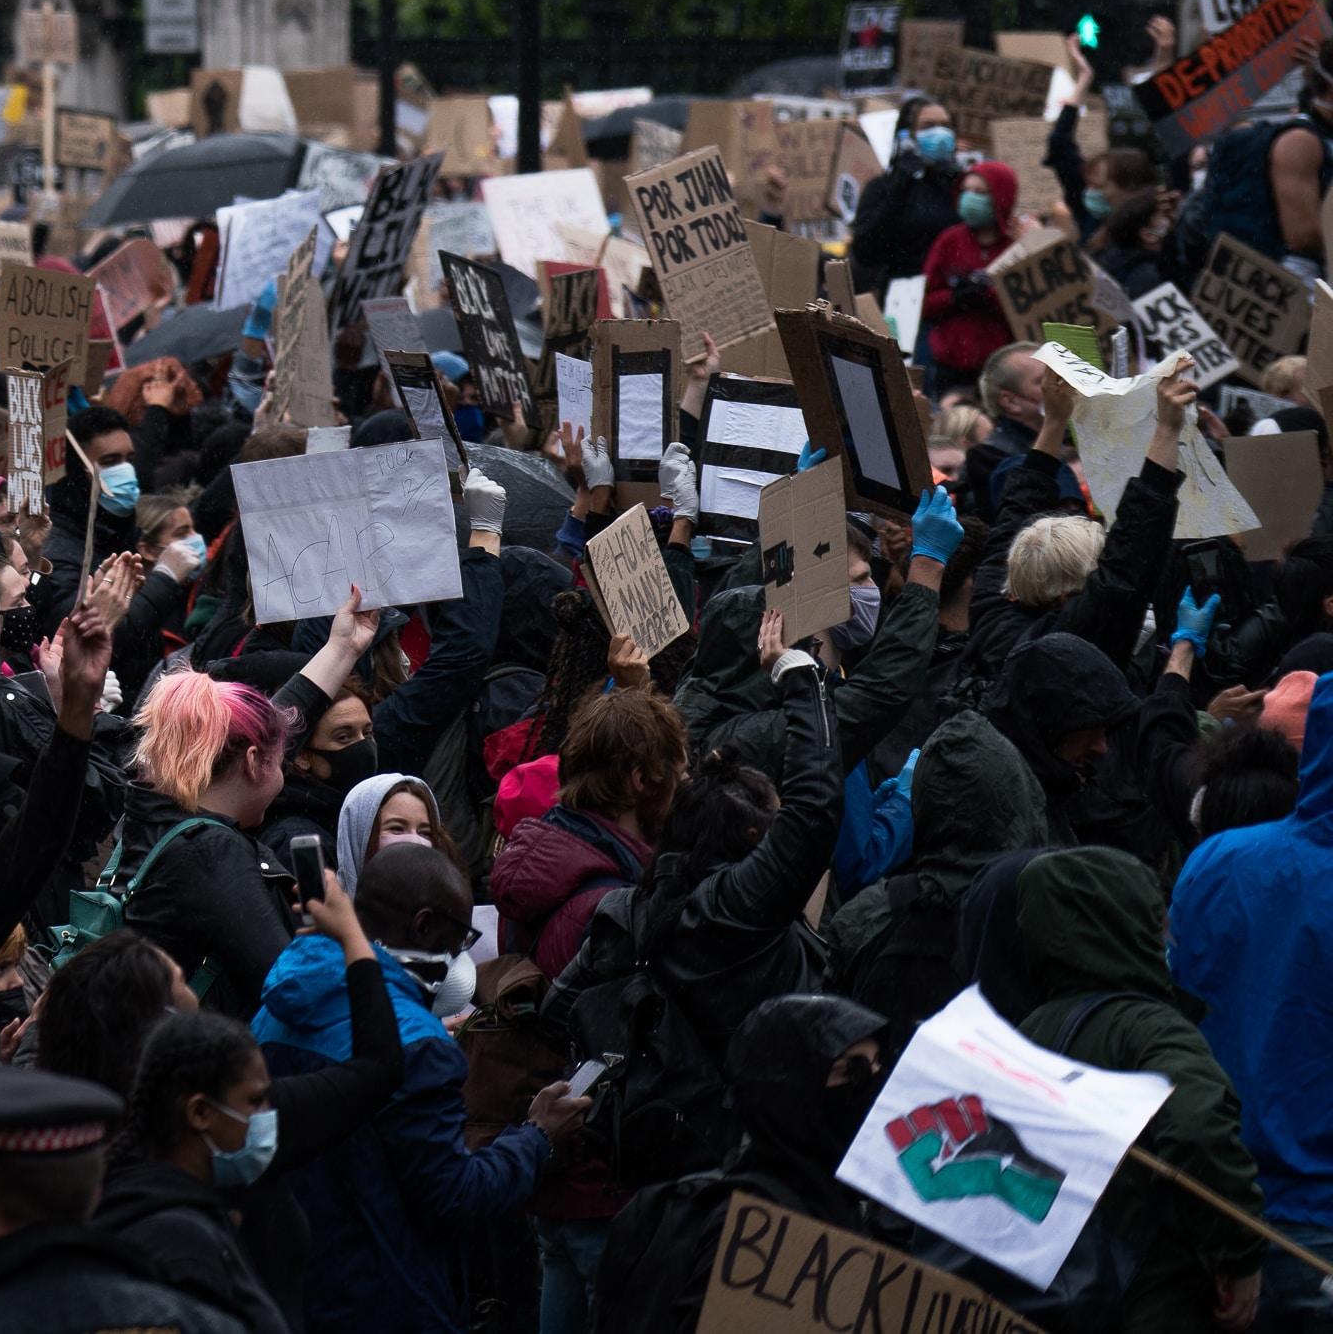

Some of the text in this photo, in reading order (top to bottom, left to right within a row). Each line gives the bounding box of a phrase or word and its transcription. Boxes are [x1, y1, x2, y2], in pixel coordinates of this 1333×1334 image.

[635, 179, 682, 230] POR
[675, 153, 732, 213] JUAN
[650, 205, 749, 274] POR TODOS
[3, 273, 92, 322] ABOLISH
[447, 263, 496, 322] BLACK
[1138, 292, 1192, 337] LACK
[1198, 274, 1281, 337] LIVES
[480, 322, 516, 370] LIVES
[263, 514, 396, 614] ACAB
[606, 517, 654, 580] HOW
[617, 566, 664, 628] MANY
[720, 1205, 907, 1334] BLACK
